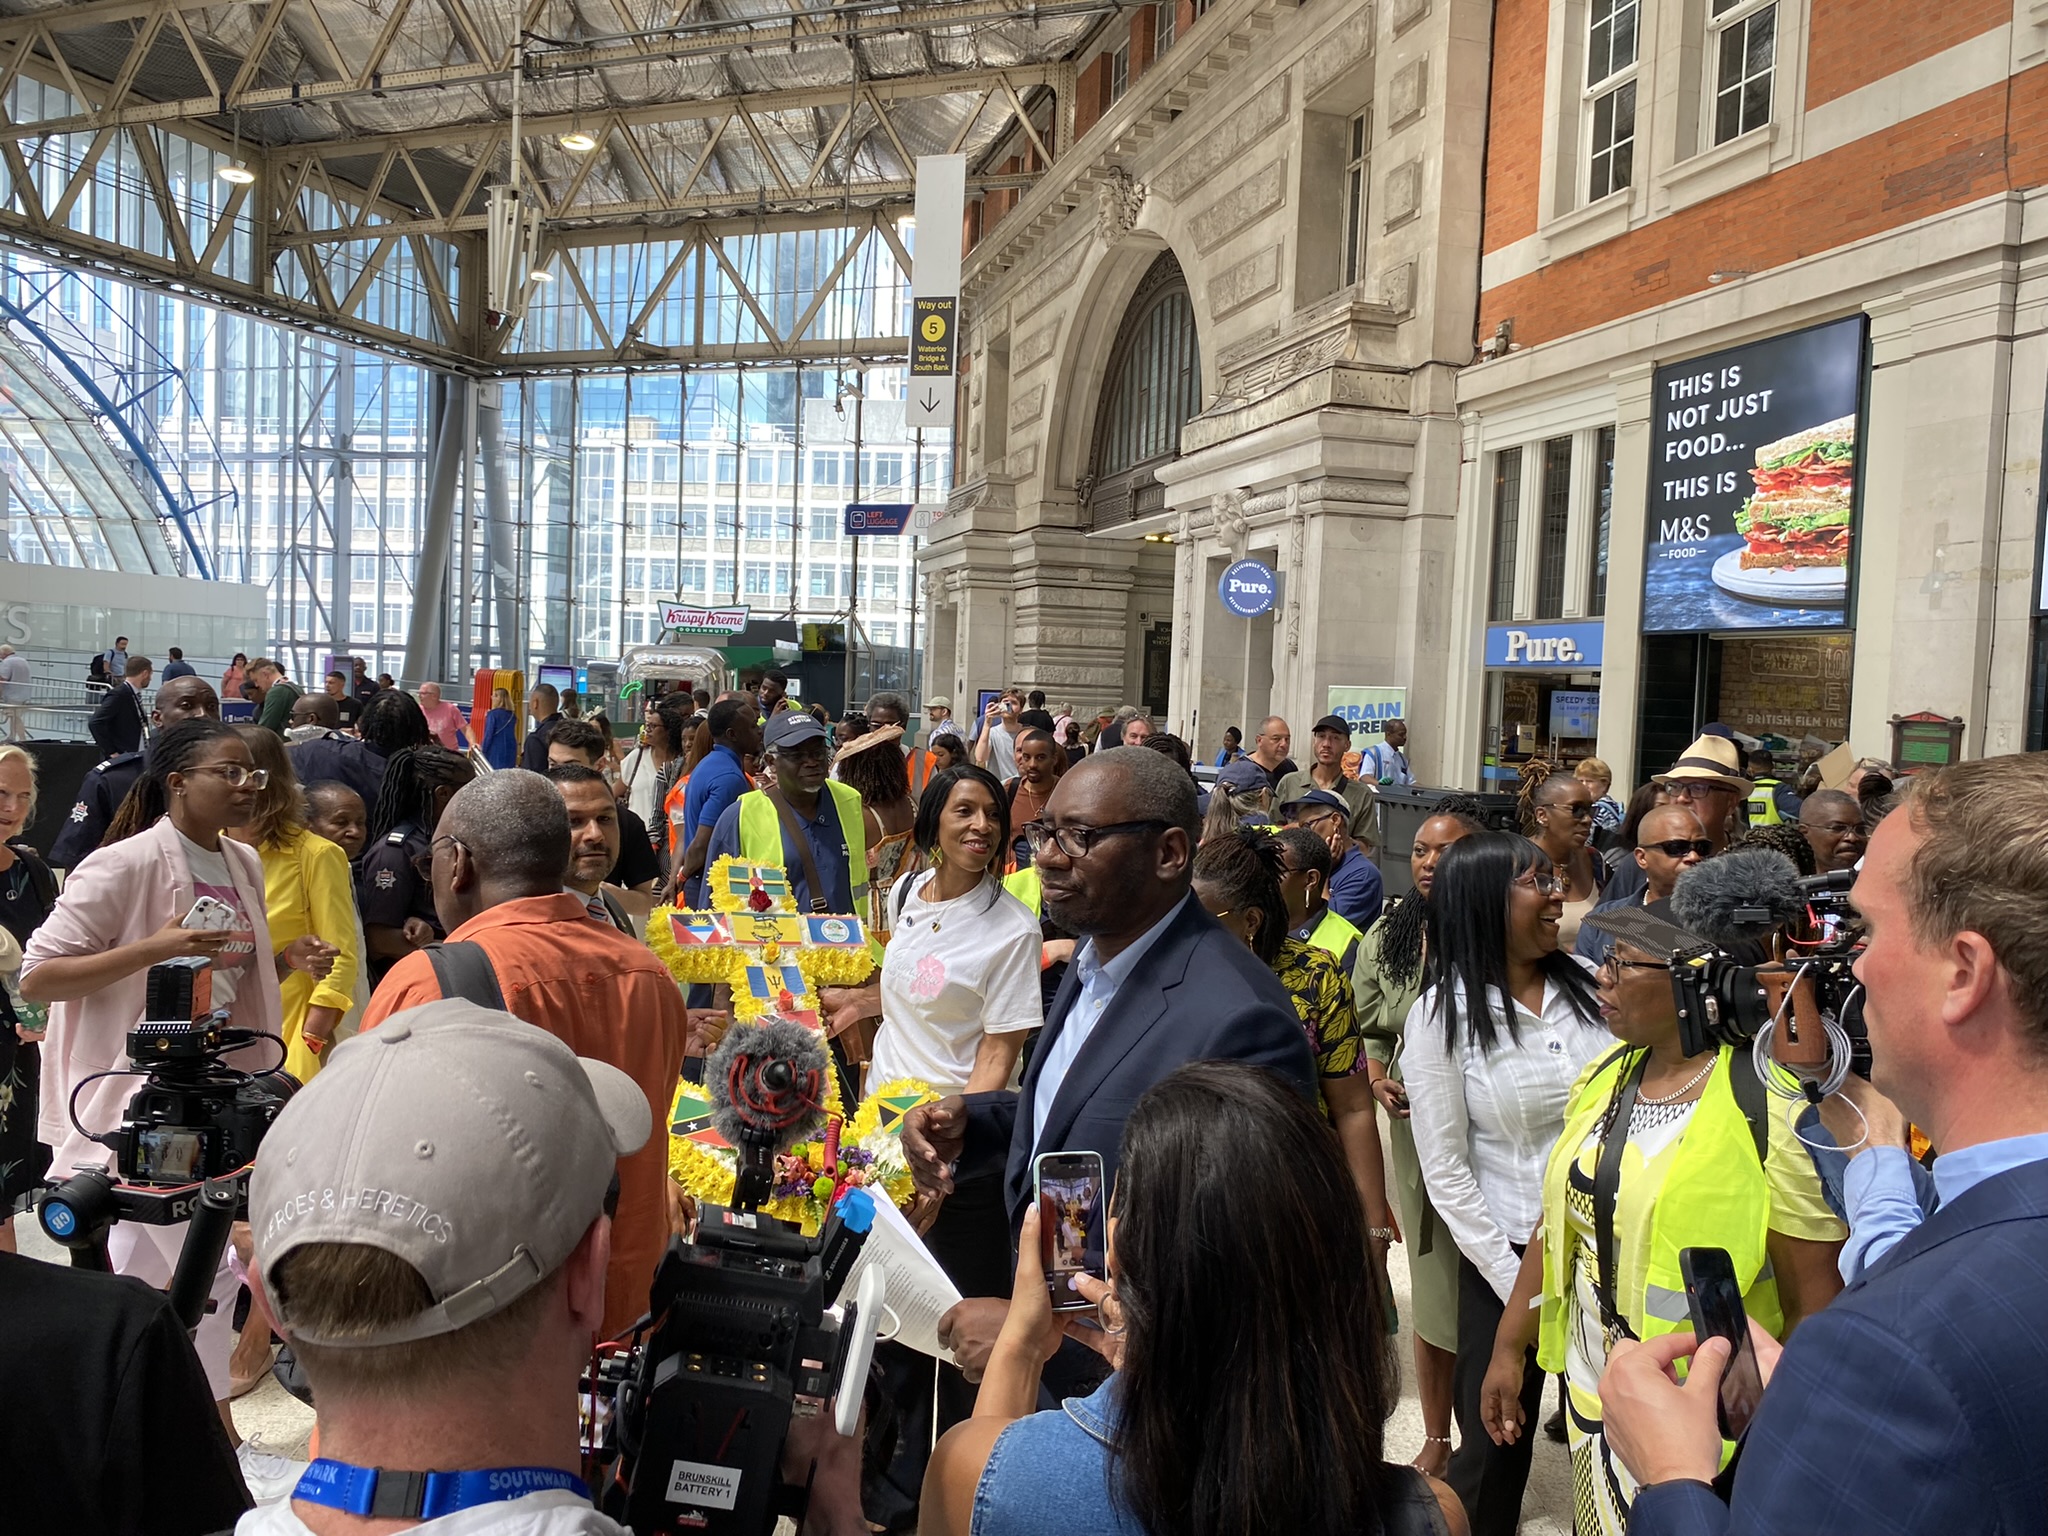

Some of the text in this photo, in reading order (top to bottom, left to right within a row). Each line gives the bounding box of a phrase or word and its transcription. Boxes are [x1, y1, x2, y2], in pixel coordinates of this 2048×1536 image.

[917, 301, 952, 311] Way out
[929, 322, 938, 335] 5
[917, 345, 948, 353] Waterloo
[918, 354, 940, 363] Bridge
[913, 364, 950, 372] South Bank
[1335, 369, 1406, 405] BANK
[1667, 365, 1742, 401] THIS IS
[1666, 389, 1774, 432] NOT JUST
[1665, 432, 1746, 463] FOOD...
[1662, 471, 1738, 502] THIS IS
[1659, 513, 1711, 546] M&S
[1668, 547, 1697, 559] FOOD
[1228, 579, 1272, 594] Pure.
[7, 605, 31, 645] S
[666, 609, 745, 627] Krispy Kreme
[679, 626, 729, 634] DOUGHNUTS
[1505, 630, 1584, 662] Pure.
[634, 653, 703, 665] EXPRESS
[1763, 652, 1808, 663] HAYWARD
[1764, 661, 1805, 672] GALLERY
[1555, 695, 1585, 704] SPEEDY
[1332, 701, 1402, 721] GRAIN
[1747, 713, 1791, 725] BRITISH
[1795, 715, 1820, 727] FILM
[52, 1211, 71, 1231] GB
[320, 1187, 335, 1210] &
[342, 1187, 453, 1244] HERETICS
[678, 1470, 732, 1487] BRUNSKILL
[673, 1481, 731, 1499] BATTERY 1
